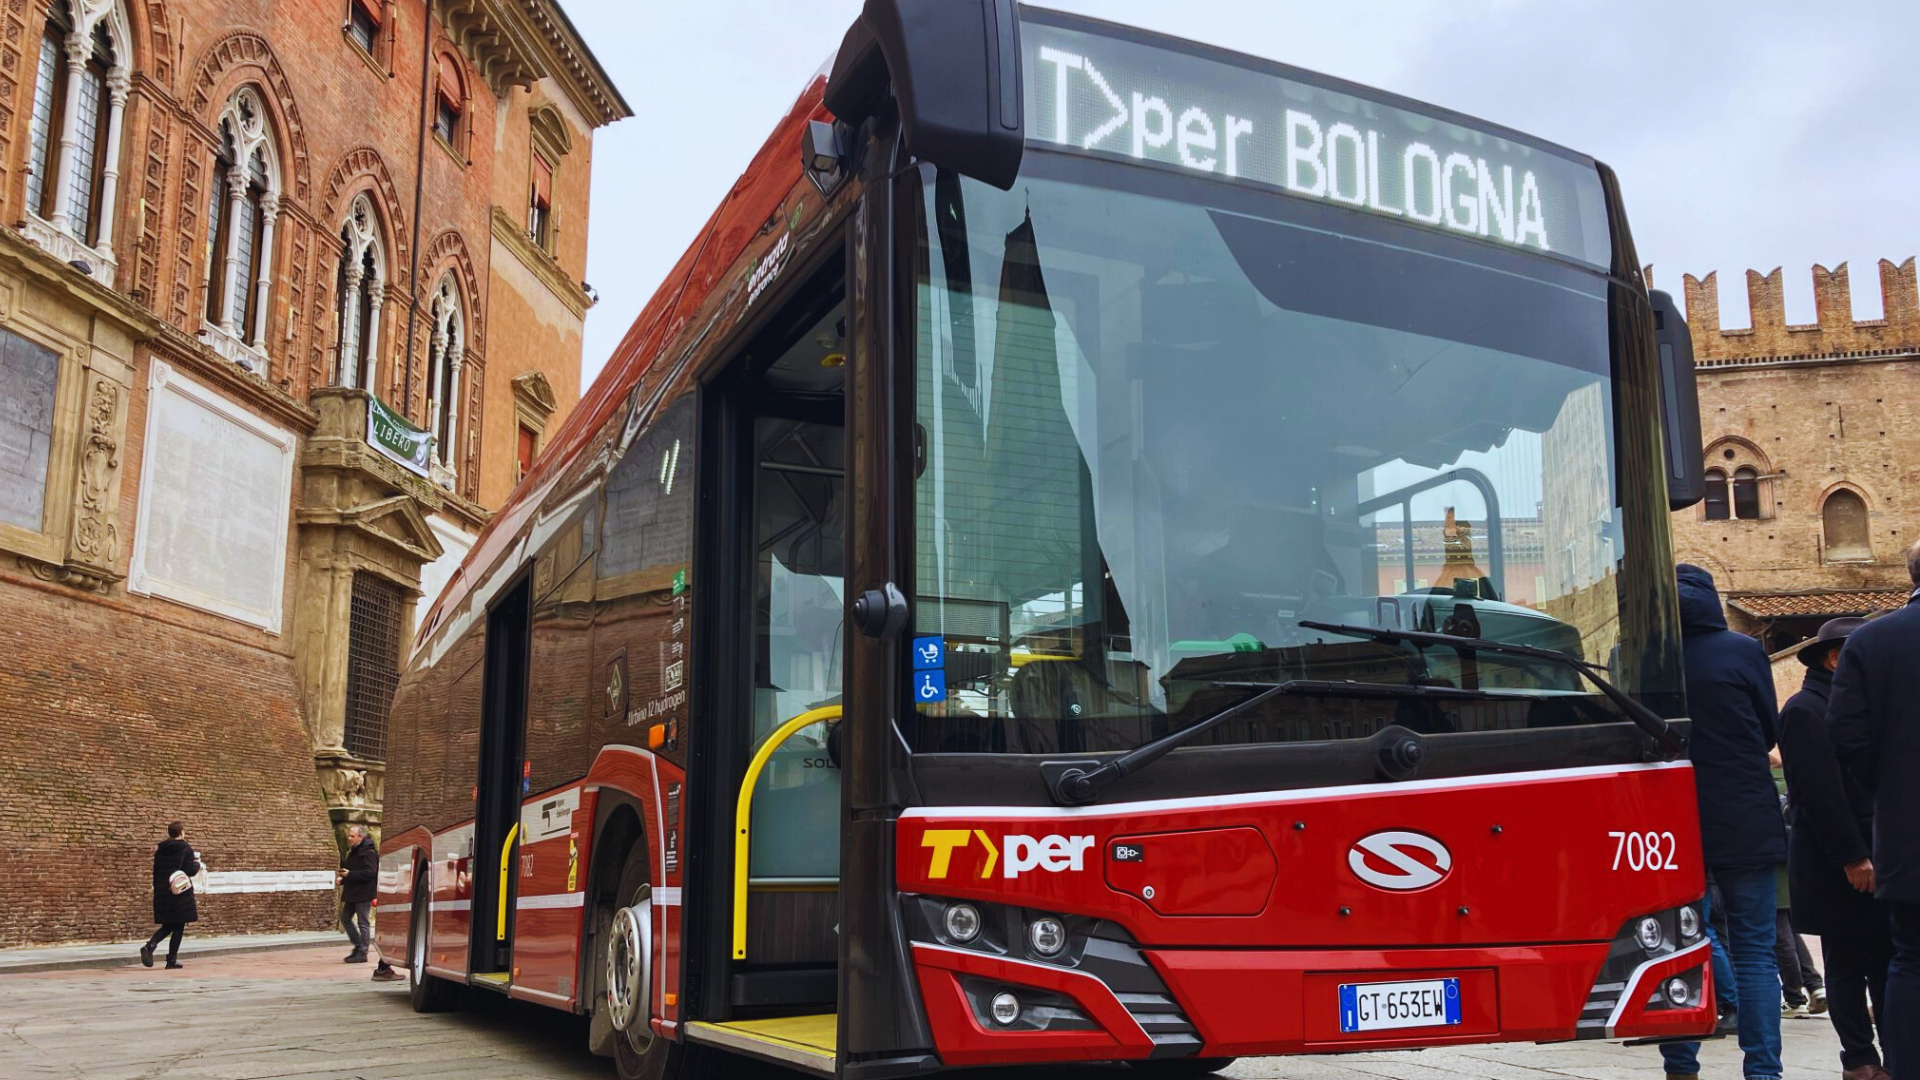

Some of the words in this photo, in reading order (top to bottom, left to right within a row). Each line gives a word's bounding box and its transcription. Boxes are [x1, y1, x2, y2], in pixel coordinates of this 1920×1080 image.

[1286, 109, 1550, 251] BOLOGNA
[373, 420, 411, 452] LIBERO
[655, 690, 686, 715] hydrogen
[1608, 831, 1679, 871] 7082
